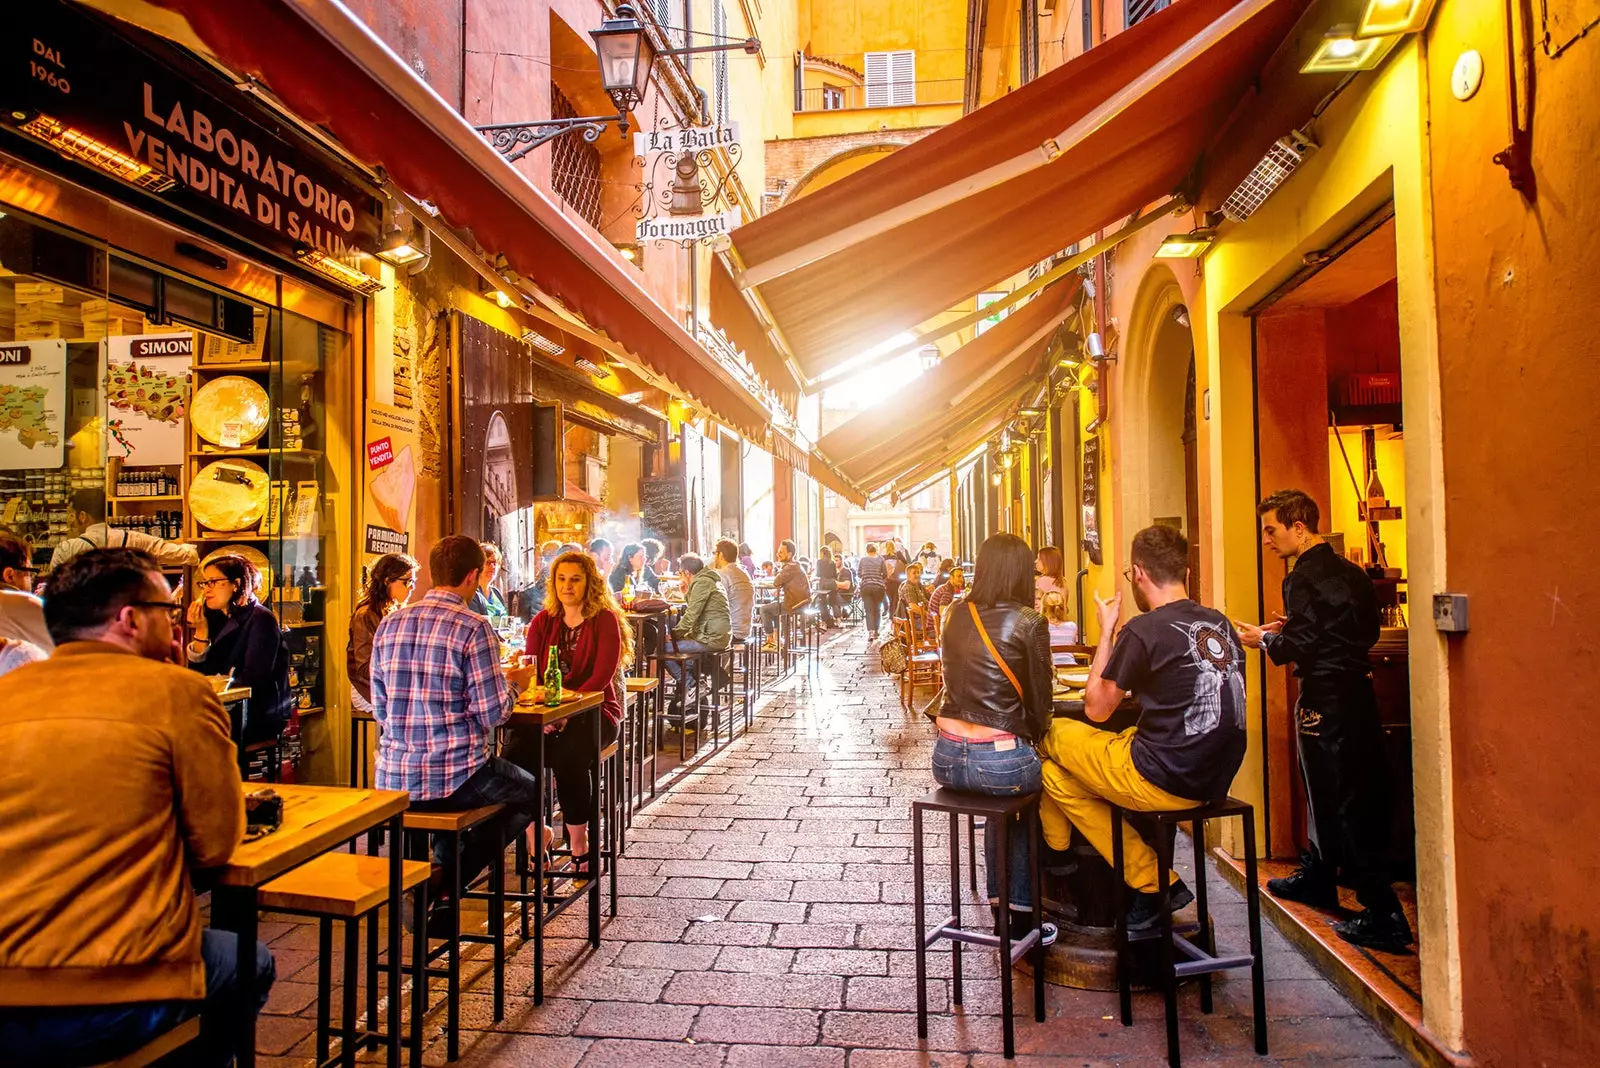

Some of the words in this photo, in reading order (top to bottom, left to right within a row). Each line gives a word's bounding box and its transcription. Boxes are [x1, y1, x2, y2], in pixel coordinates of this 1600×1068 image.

[32, 37, 65, 69] DAL
[30, 60, 71, 95] 1960
[649, 131, 673, 150] La
[679, 126, 734, 148] Baita
[143, 82, 355, 232] LABORATORIO
[123, 121, 250, 215] VENDITA
[257, 192, 282, 230] DI
[636, 213, 726, 240] Formaggi
[140, 340, 192, 355] SIMONI
[370, 441, 389, 454] PUNTO
[370, 451, 393, 465] VENDITA
[367, 527, 408, 545] PARMIGIANO
[371, 540, 403, 555] REGGIANO
